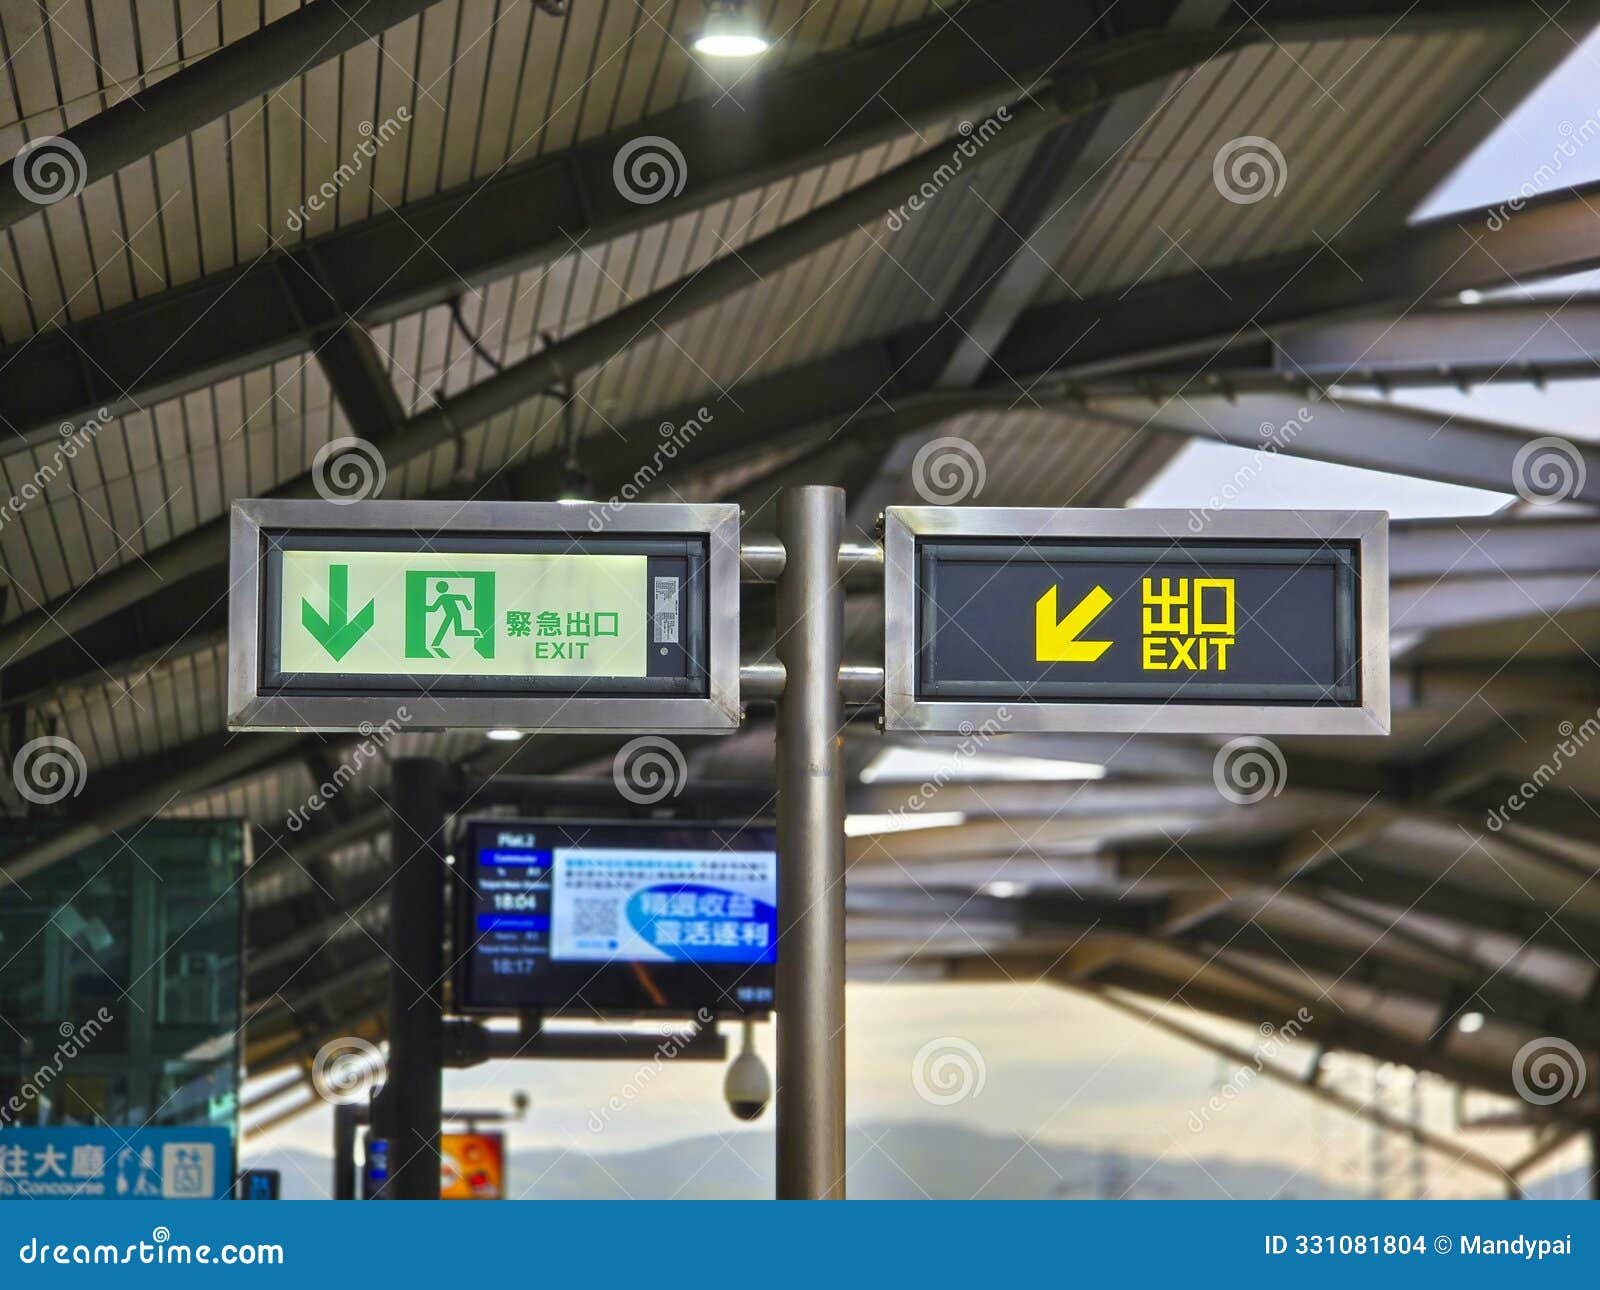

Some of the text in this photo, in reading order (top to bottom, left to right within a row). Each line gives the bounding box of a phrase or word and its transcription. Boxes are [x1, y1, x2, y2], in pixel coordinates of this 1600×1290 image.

[1142, 578, 1235, 635] 出口
[506, 611, 619, 637] 緊急出口
[535, 642, 590, 659] EXIT
[1142, 637, 1235, 671] EXIT
